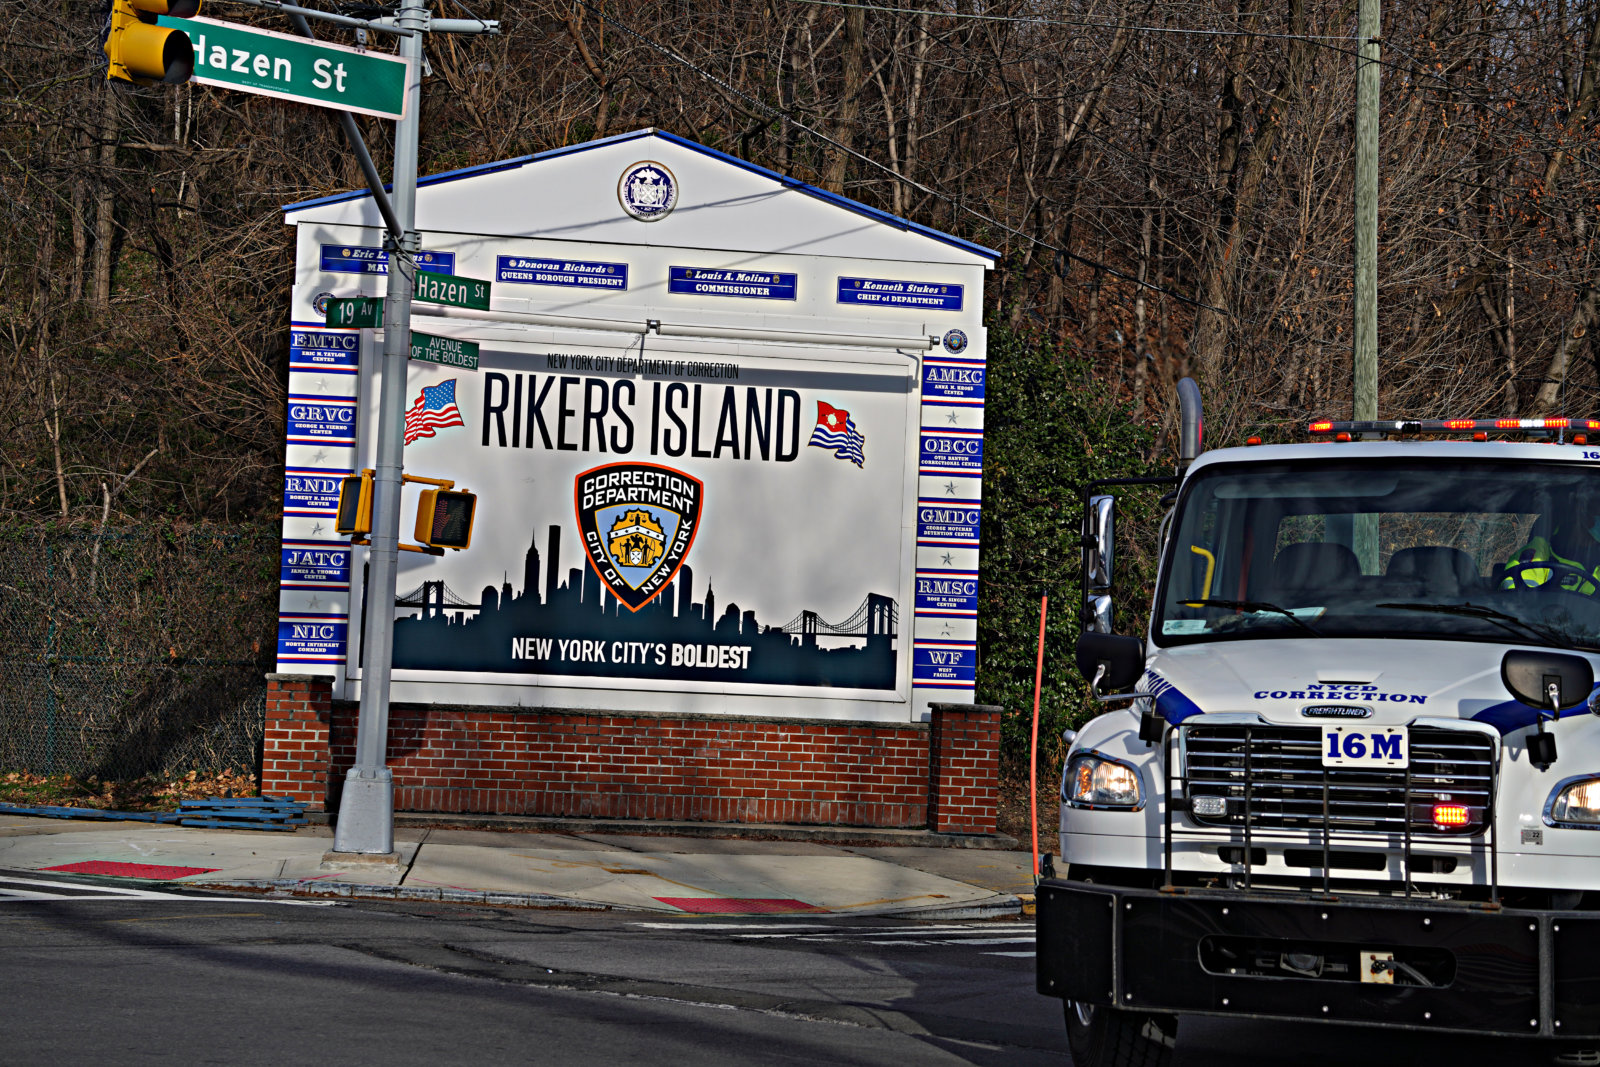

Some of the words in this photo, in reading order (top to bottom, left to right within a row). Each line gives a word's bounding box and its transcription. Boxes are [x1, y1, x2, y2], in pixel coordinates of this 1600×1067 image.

[185, 31, 291, 82] Hazen
[312, 58, 348, 93] St
[352, 249, 375, 258] Eric
[376, 251, 386, 259] L.
[367, 263, 389, 273] MAY
[517, 260, 560, 270] Donovan
[563, 263, 606, 273] Richards
[501, 271, 533, 280] QUEENS
[536, 273, 575, 283] BOROUGH
[577, 276, 623, 286] PRESIDENT
[694, 270, 722, 280] Louis
[724, 272, 734, 281] A.
[736, 273, 770, 283] Molina
[418, 275, 467, 303] Hazen
[475, 284, 485, 298] St
[695, 283, 770, 296] COMMISSIONER
[862, 281, 903, 292] Kenneth
[906, 283, 939, 294] Stukes
[857, 293, 882, 301] CHIEF
[882, 294, 890, 302] of
[891, 295, 944, 305] DEPARTMENT
[339, 302, 354, 324] 19
[361, 302, 372, 316] Av
[292, 333, 356, 350] EMTC
[429, 337, 462, 353] AVENUE
[411, 345, 422, 357] OF
[425, 347, 440, 361] THE
[442, 351, 478, 368] BOLDEST
[547, 353, 568, 369] NEW
[570, 355, 593, 371] YORK
[596, 356, 615, 372] CITY
[616, 357, 673, 376] DEPARTMENT
[674, 361, 686, 377] OF
[687, 361, 739, 379] CORRECTION
[926, 368, 983, 383] AMKC
[290, 406, 353, 422] GRVC
[482, 371, 636, 454] RIKERS
[650, 381, 801, 462] ISLAND
[925, 439, 979, 454] OBCC
[583, 471, 694, 499] CORRECTION
[582, 487, 694, 514] DEPARTMENT
[921, 509, 979, 525] GMDC
[288, 551, 345, 567] JATC
[586, 531, 608, 564] CITY
[603, 568, 624, 587] OF
[640, 563, 671, 595] NEW
[667, 519, 693, 561] YORK
[918, 580, 976, 595] RMSC
[292, 624, 335, 639] NIC
[511, 637, 553, 661] NEW
[558, 639, 606, 663] YORK
[611, 641, 666, 665] CITY'S
[671, 643, 752, 669] BOLDEST
[928, 650, 964, 665] WF
[1306, 684, 1378, 692] NYCD
[1254, 690, 1428, 704] CORRECTION
[1308, 707, 1365, 716] FREIGHTLINER
